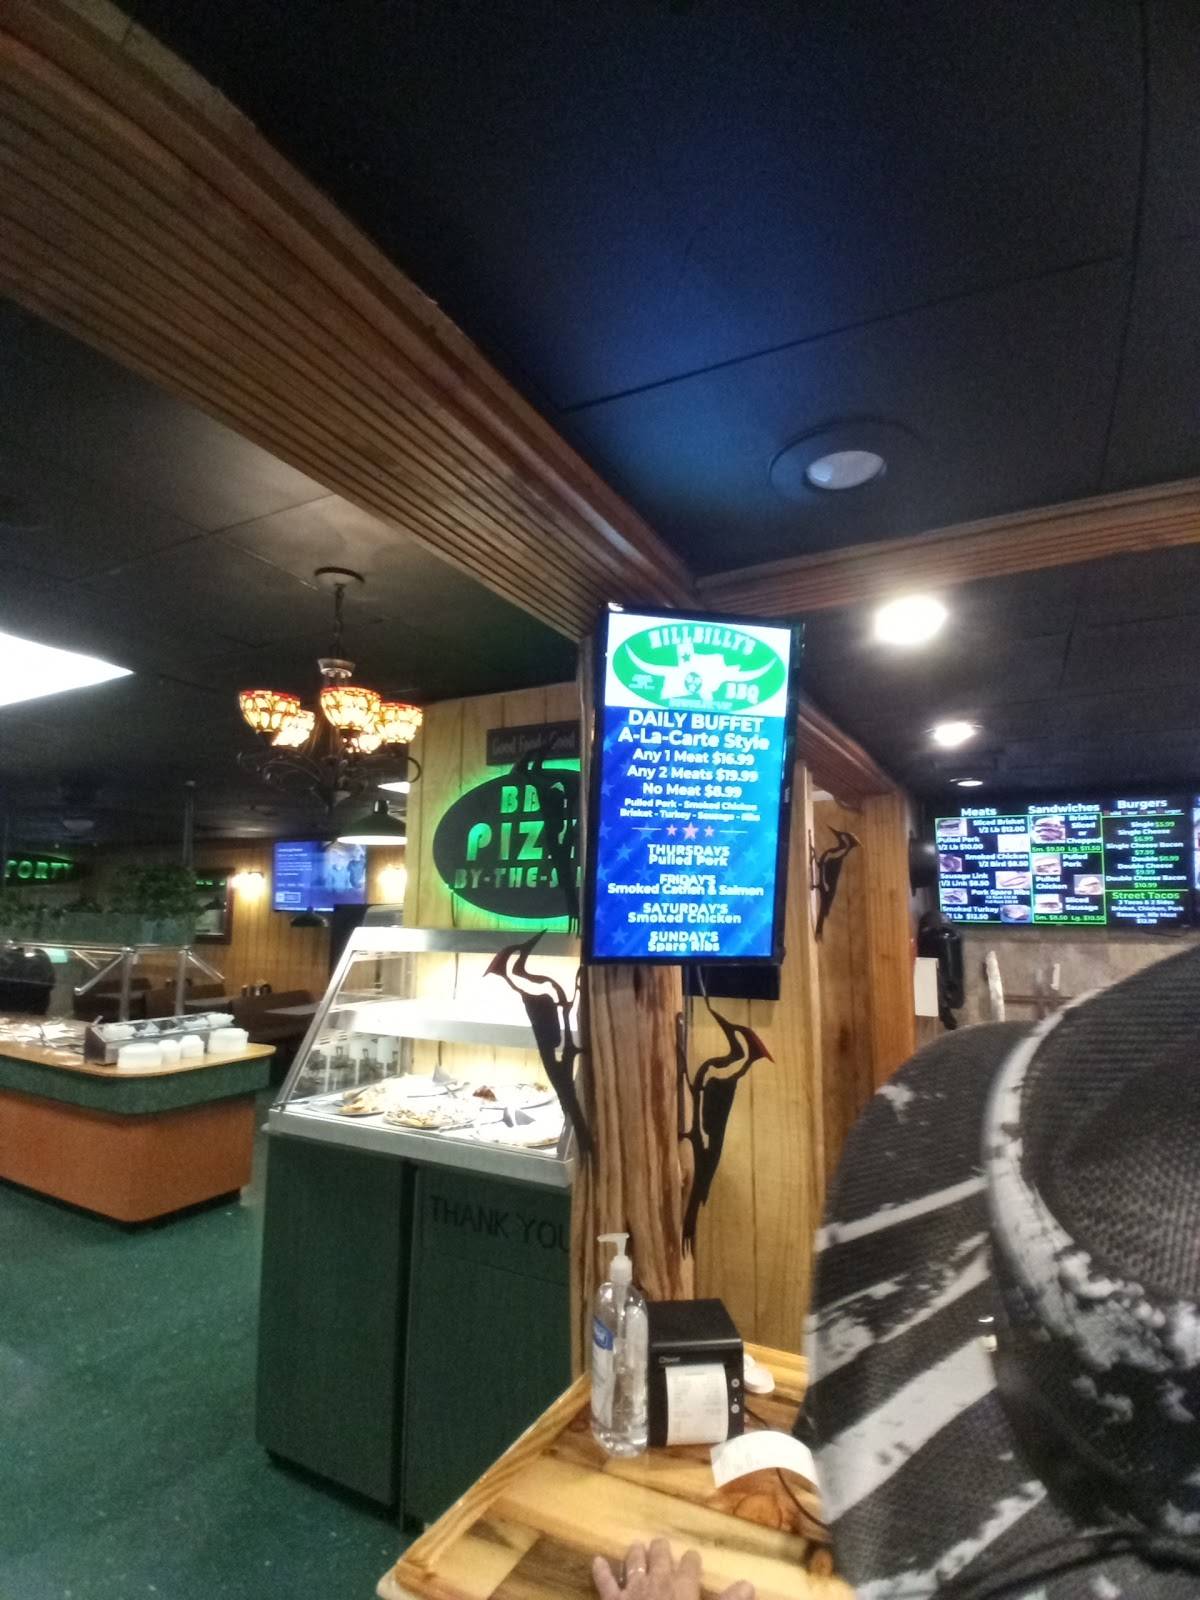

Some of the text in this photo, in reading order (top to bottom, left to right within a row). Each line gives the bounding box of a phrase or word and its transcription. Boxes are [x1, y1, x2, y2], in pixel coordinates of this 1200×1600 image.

[628, 710, 765, 733] DAILY BUFFET
[618, 727, 769, 752] A-La-Carte Style
[633, 749, 662, 763] Any
[665, 751, 670, 761] 1
[674, 751, 709, 763] Meat
[627, 765, 656, 779] Any
[659, 767, 667, 778] 2
[671, 768, 713, 780] Meats
[643, 783, 663, 794] No
[666, 784, 701, 796] Meat
[625, 798, 653, 807] Pulled
[655, 799, 676, 808] Pork
[1028, 804, 1100, 814] Sandwiches
[1118, 800, 1167, 810] Burgers
[620, 808, 653, 817] Brisket
[660, 810, 691, 820] Turkey
[961, 808, 997, 816] Meats
[649, 853, 728, 866] Pulled Pork
[608, 883, 763, 896] Smoked Catfish & Salmon
[628, 912, 741, 923] Smoked Chicken
[648, 942, 720, 952] Spare Ribs
[430, 1195, 509, 1238] THANK
